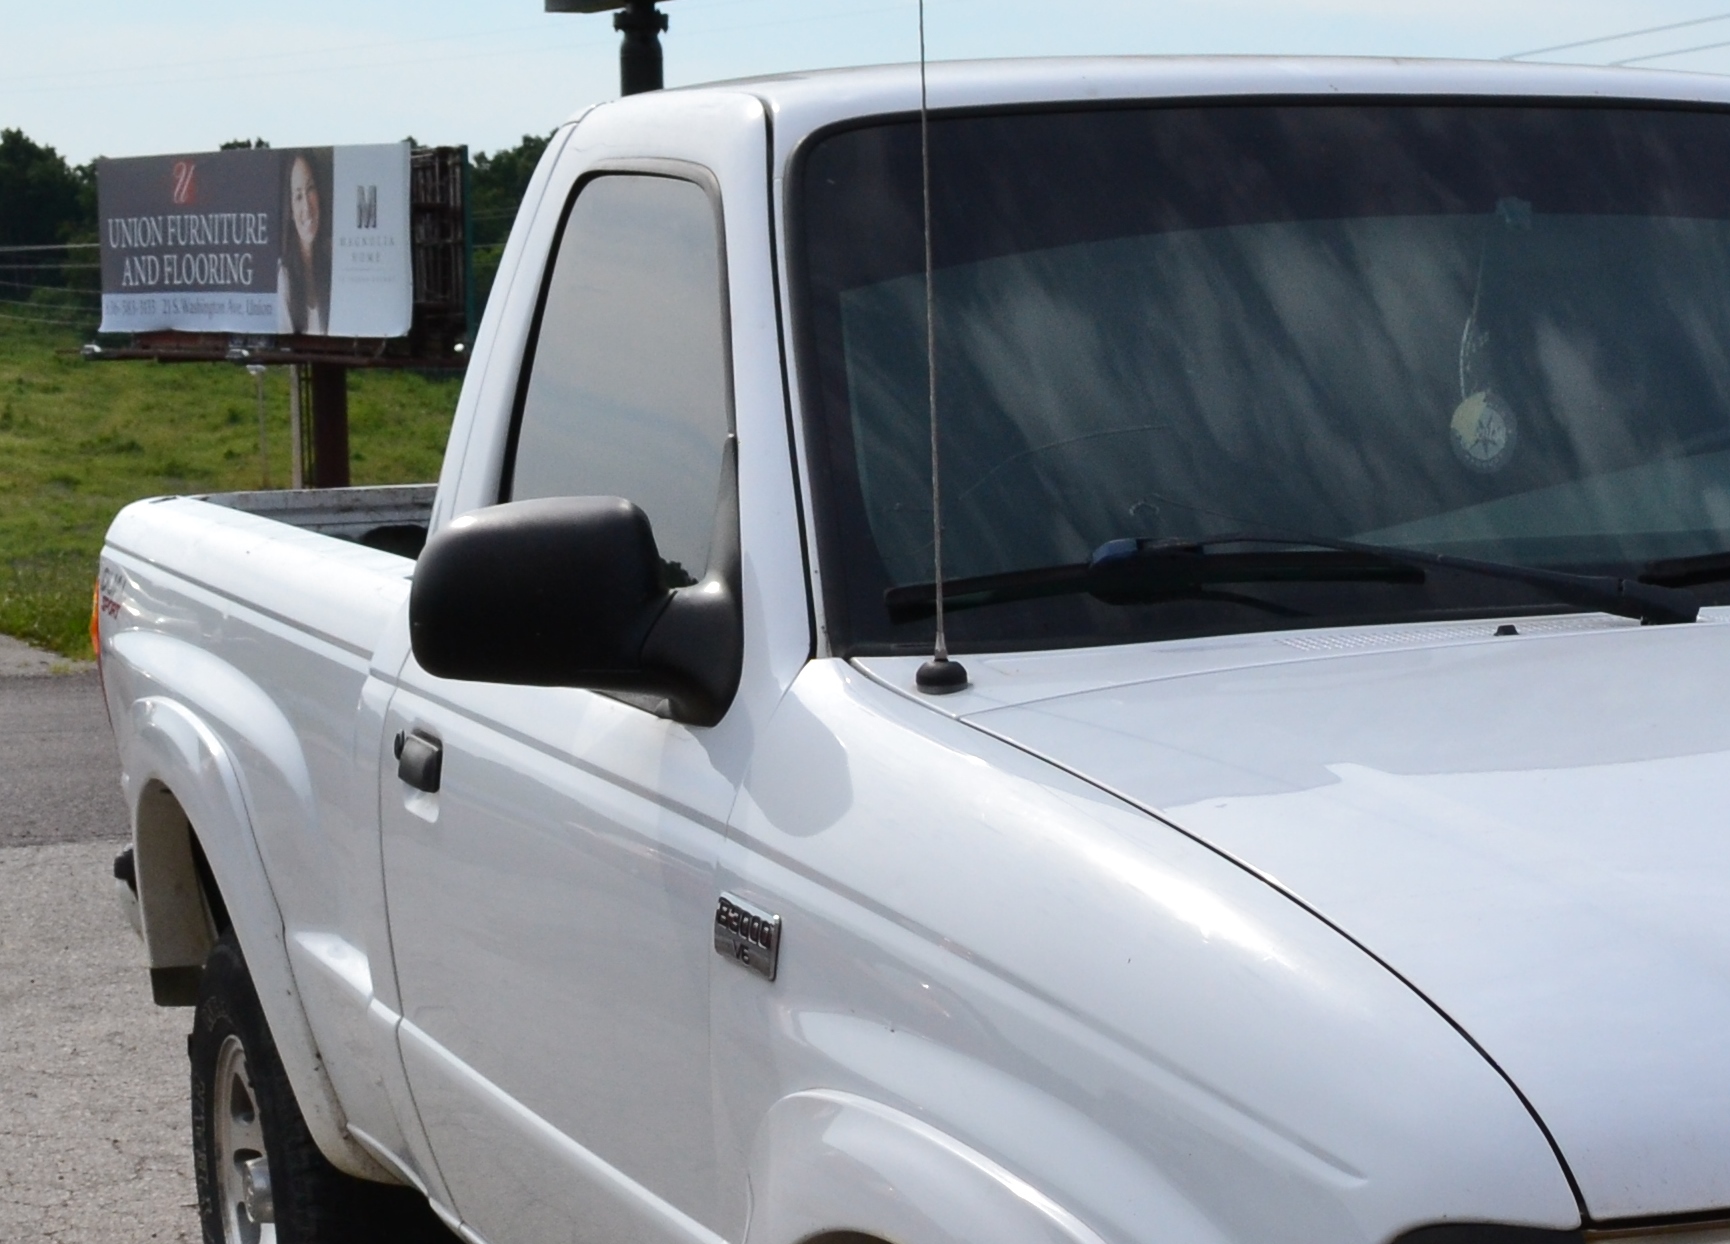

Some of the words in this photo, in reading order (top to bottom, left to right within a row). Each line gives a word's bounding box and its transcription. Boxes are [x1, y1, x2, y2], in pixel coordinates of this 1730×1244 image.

[108, 216, 163, 248] UNION
[167, 213, 269, 246] FURNITURE
[122, 255, 160, 286] AND
[163, 253, 253, 286] FLOORING
